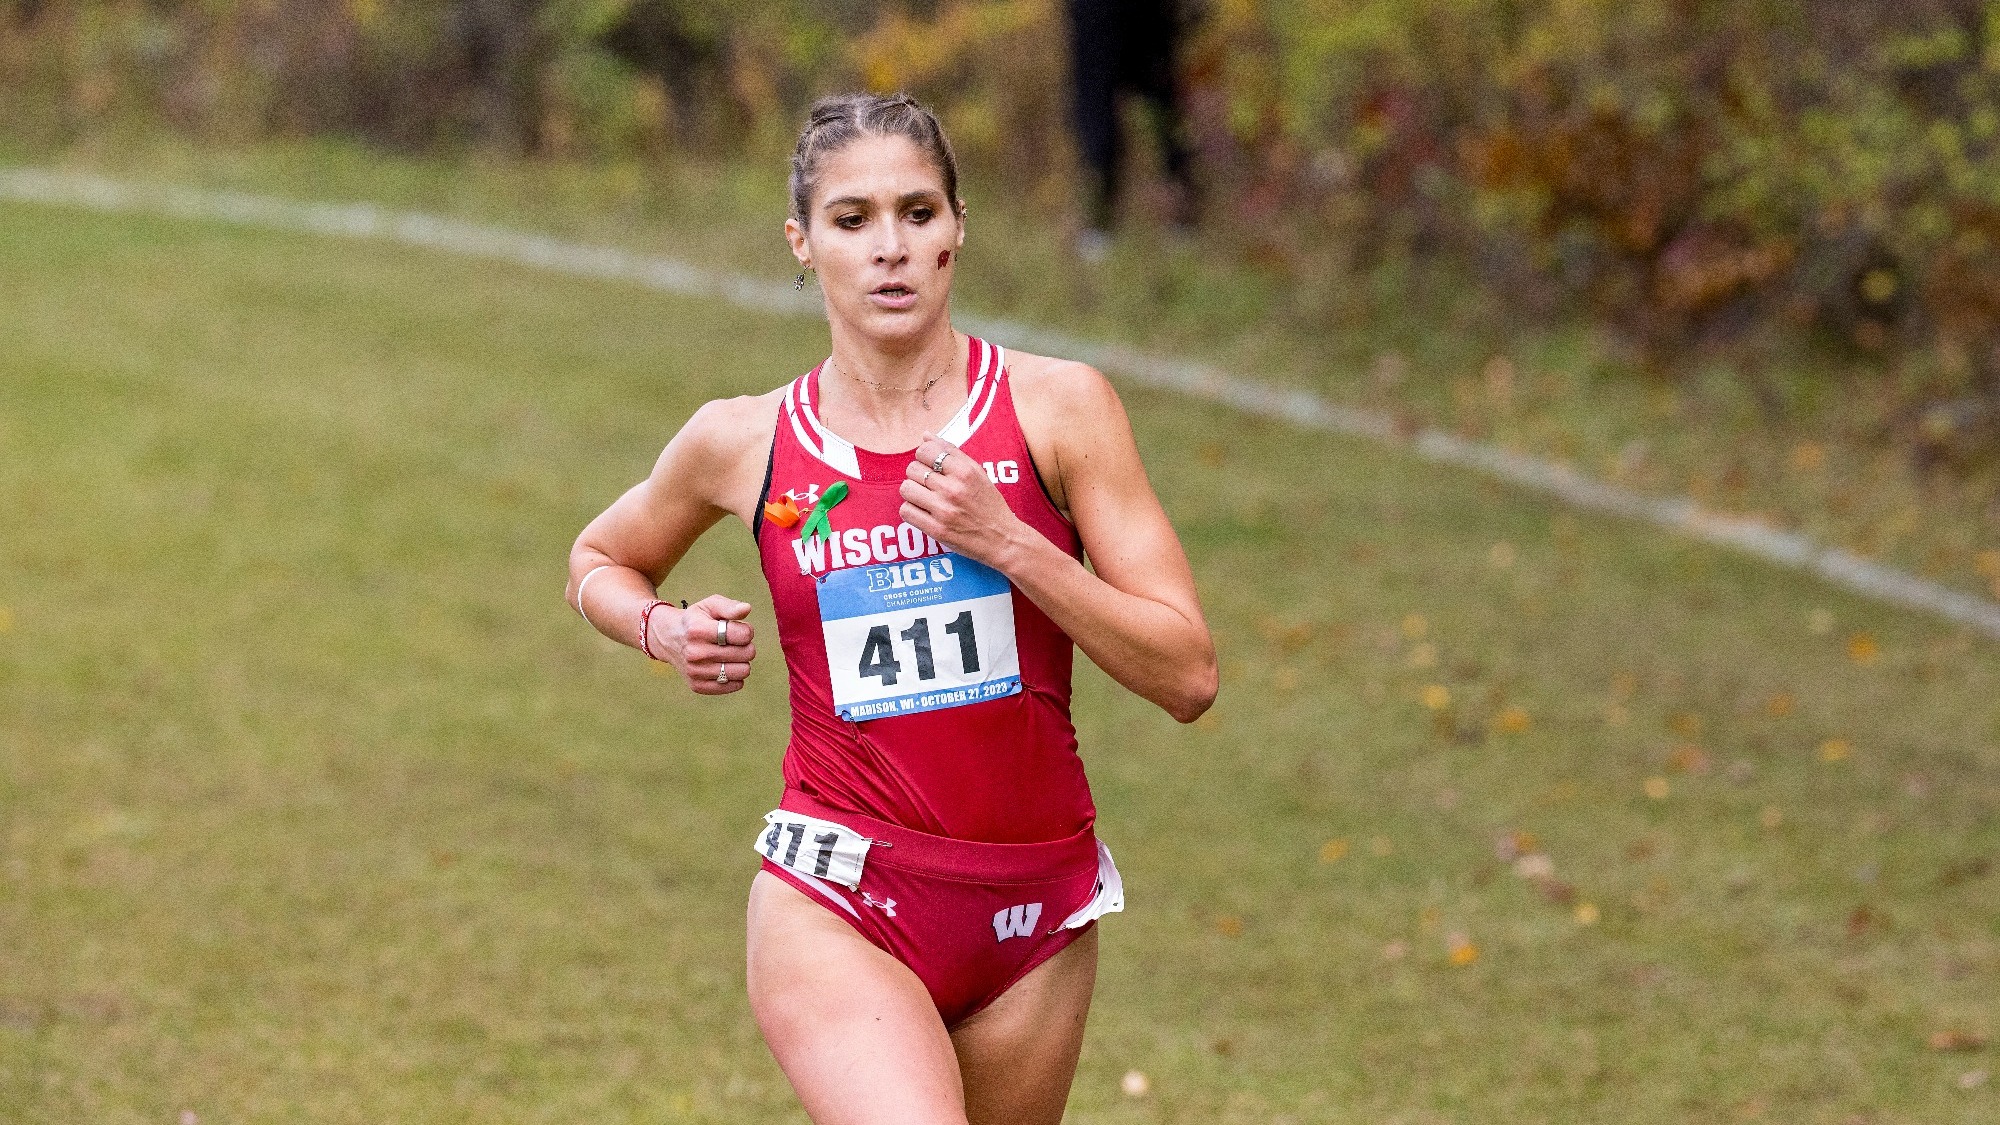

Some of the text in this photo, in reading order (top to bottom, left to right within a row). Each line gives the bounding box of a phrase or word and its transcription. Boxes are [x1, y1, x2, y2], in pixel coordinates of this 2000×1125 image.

[883, 587, 943, 600] CROSS COUNTRY
[886, 594, 943, 607] CHAMPIONSHIPS
[858, 610, 980, 686] 411
[850, 682, 1008, 717] MADISON, WI OCTOBER 27, 2023
[765, 822, 839, 877] 411
[992, 902, 1043, 943] W
